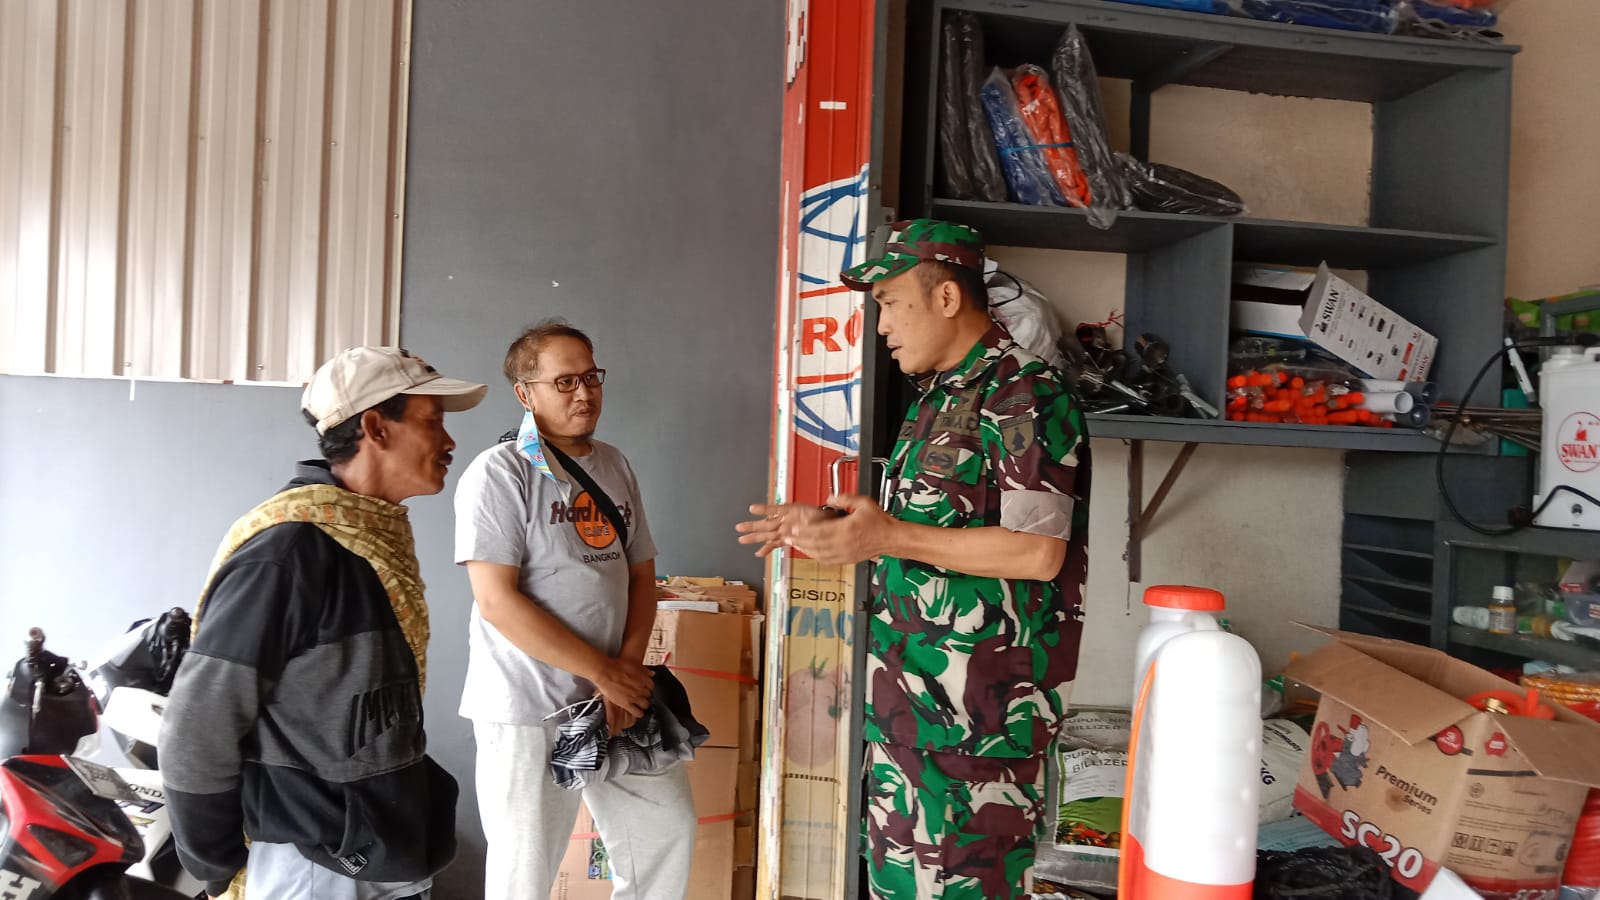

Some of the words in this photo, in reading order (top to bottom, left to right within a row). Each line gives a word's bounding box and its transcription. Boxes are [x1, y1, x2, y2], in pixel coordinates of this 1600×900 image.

[1322, 289, 1339, 321] SWAN
[1561, 443, 1597, 459] SWAN
[550, 500, 593, 525] Hard
[128, 783, 166, 800] OND
[1375, 764, 1439, 807] Premium
[1403, 794, 1433, 815] Series
[1340, 808, 1425, 880] SC20
